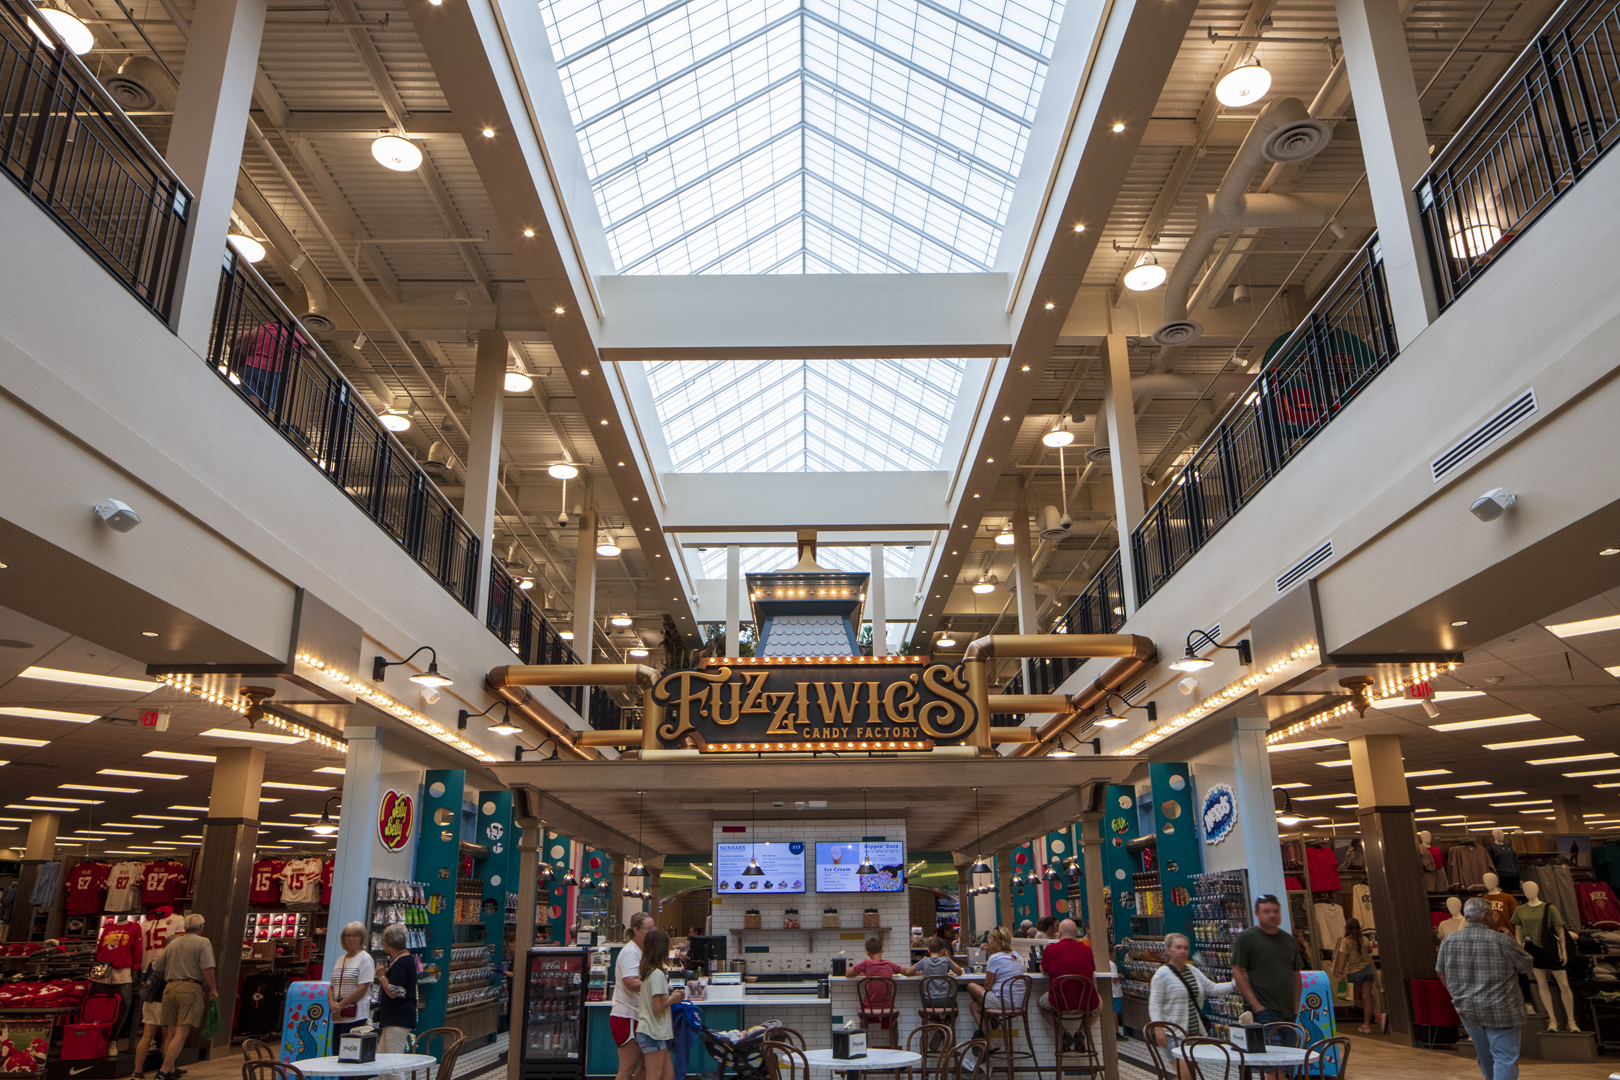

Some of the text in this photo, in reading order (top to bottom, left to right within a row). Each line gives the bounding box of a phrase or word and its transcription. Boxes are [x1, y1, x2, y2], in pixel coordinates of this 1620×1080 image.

[1411, 682, 1429, 697] EXIT
[143, 712, 159, 726] EXI
[803, 727, 919, 739] CANDY FACTORY
[391, 793, 407, 824] Jelly
[384, 815, 403, 848] Belly
[77, 876, 92, 890] 87
[116, 877, 130, 889] 87
[146, 873, 169, 891] 87
[255, 873, 272, 891] 15
[289, 873, 305, 890] 15
[1589, 891, 1608, 901] NIKE
[145, 927, 167, 951] 15
